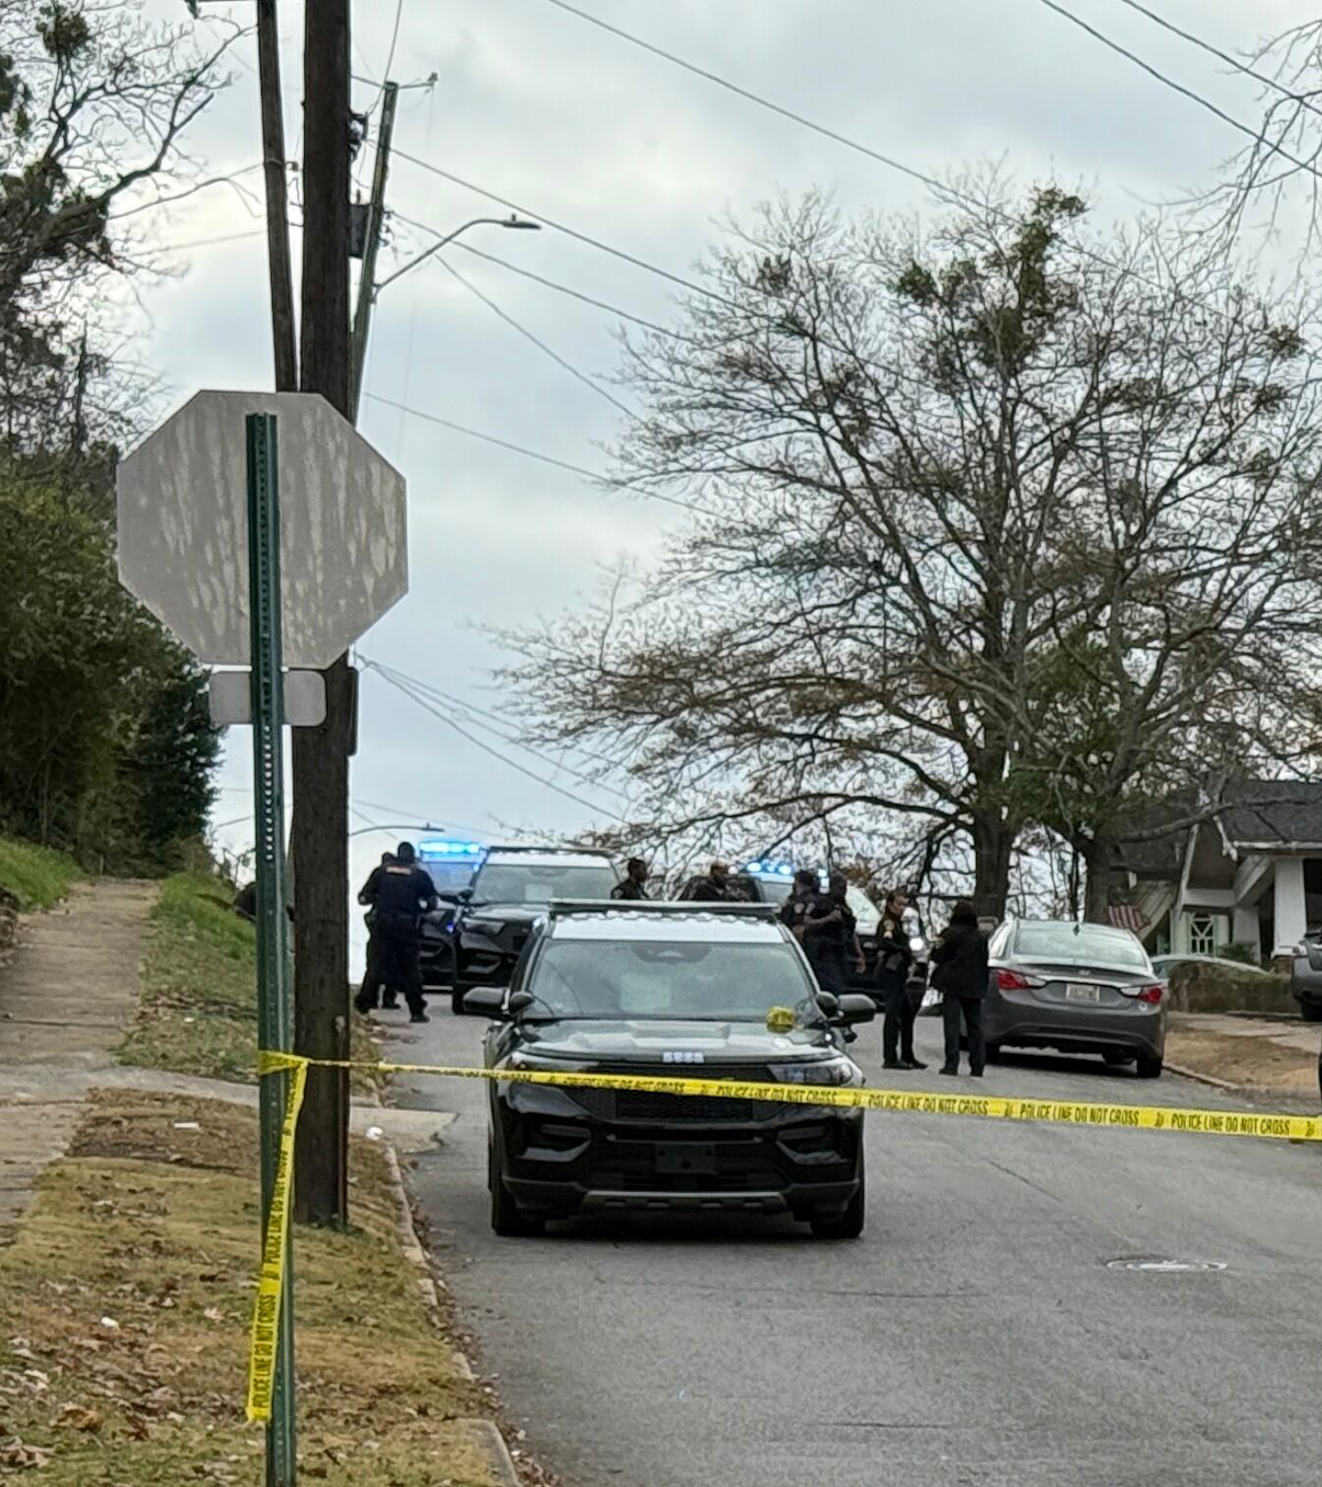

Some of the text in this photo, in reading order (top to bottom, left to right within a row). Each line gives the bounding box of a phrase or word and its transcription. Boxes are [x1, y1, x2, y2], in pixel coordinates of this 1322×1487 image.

[868, 1093, 989, 1115] POLICE LINE DO NOT CROSS
[1019, 1103, 1140, 1126] POLICE LINE DO NOT CROSS
[1171, 1113, 1290, 1134] POLICE LINE DO NOT CROSS
[252, 1295, 276, 1408] POLICE LINE DO NOT CROSS
